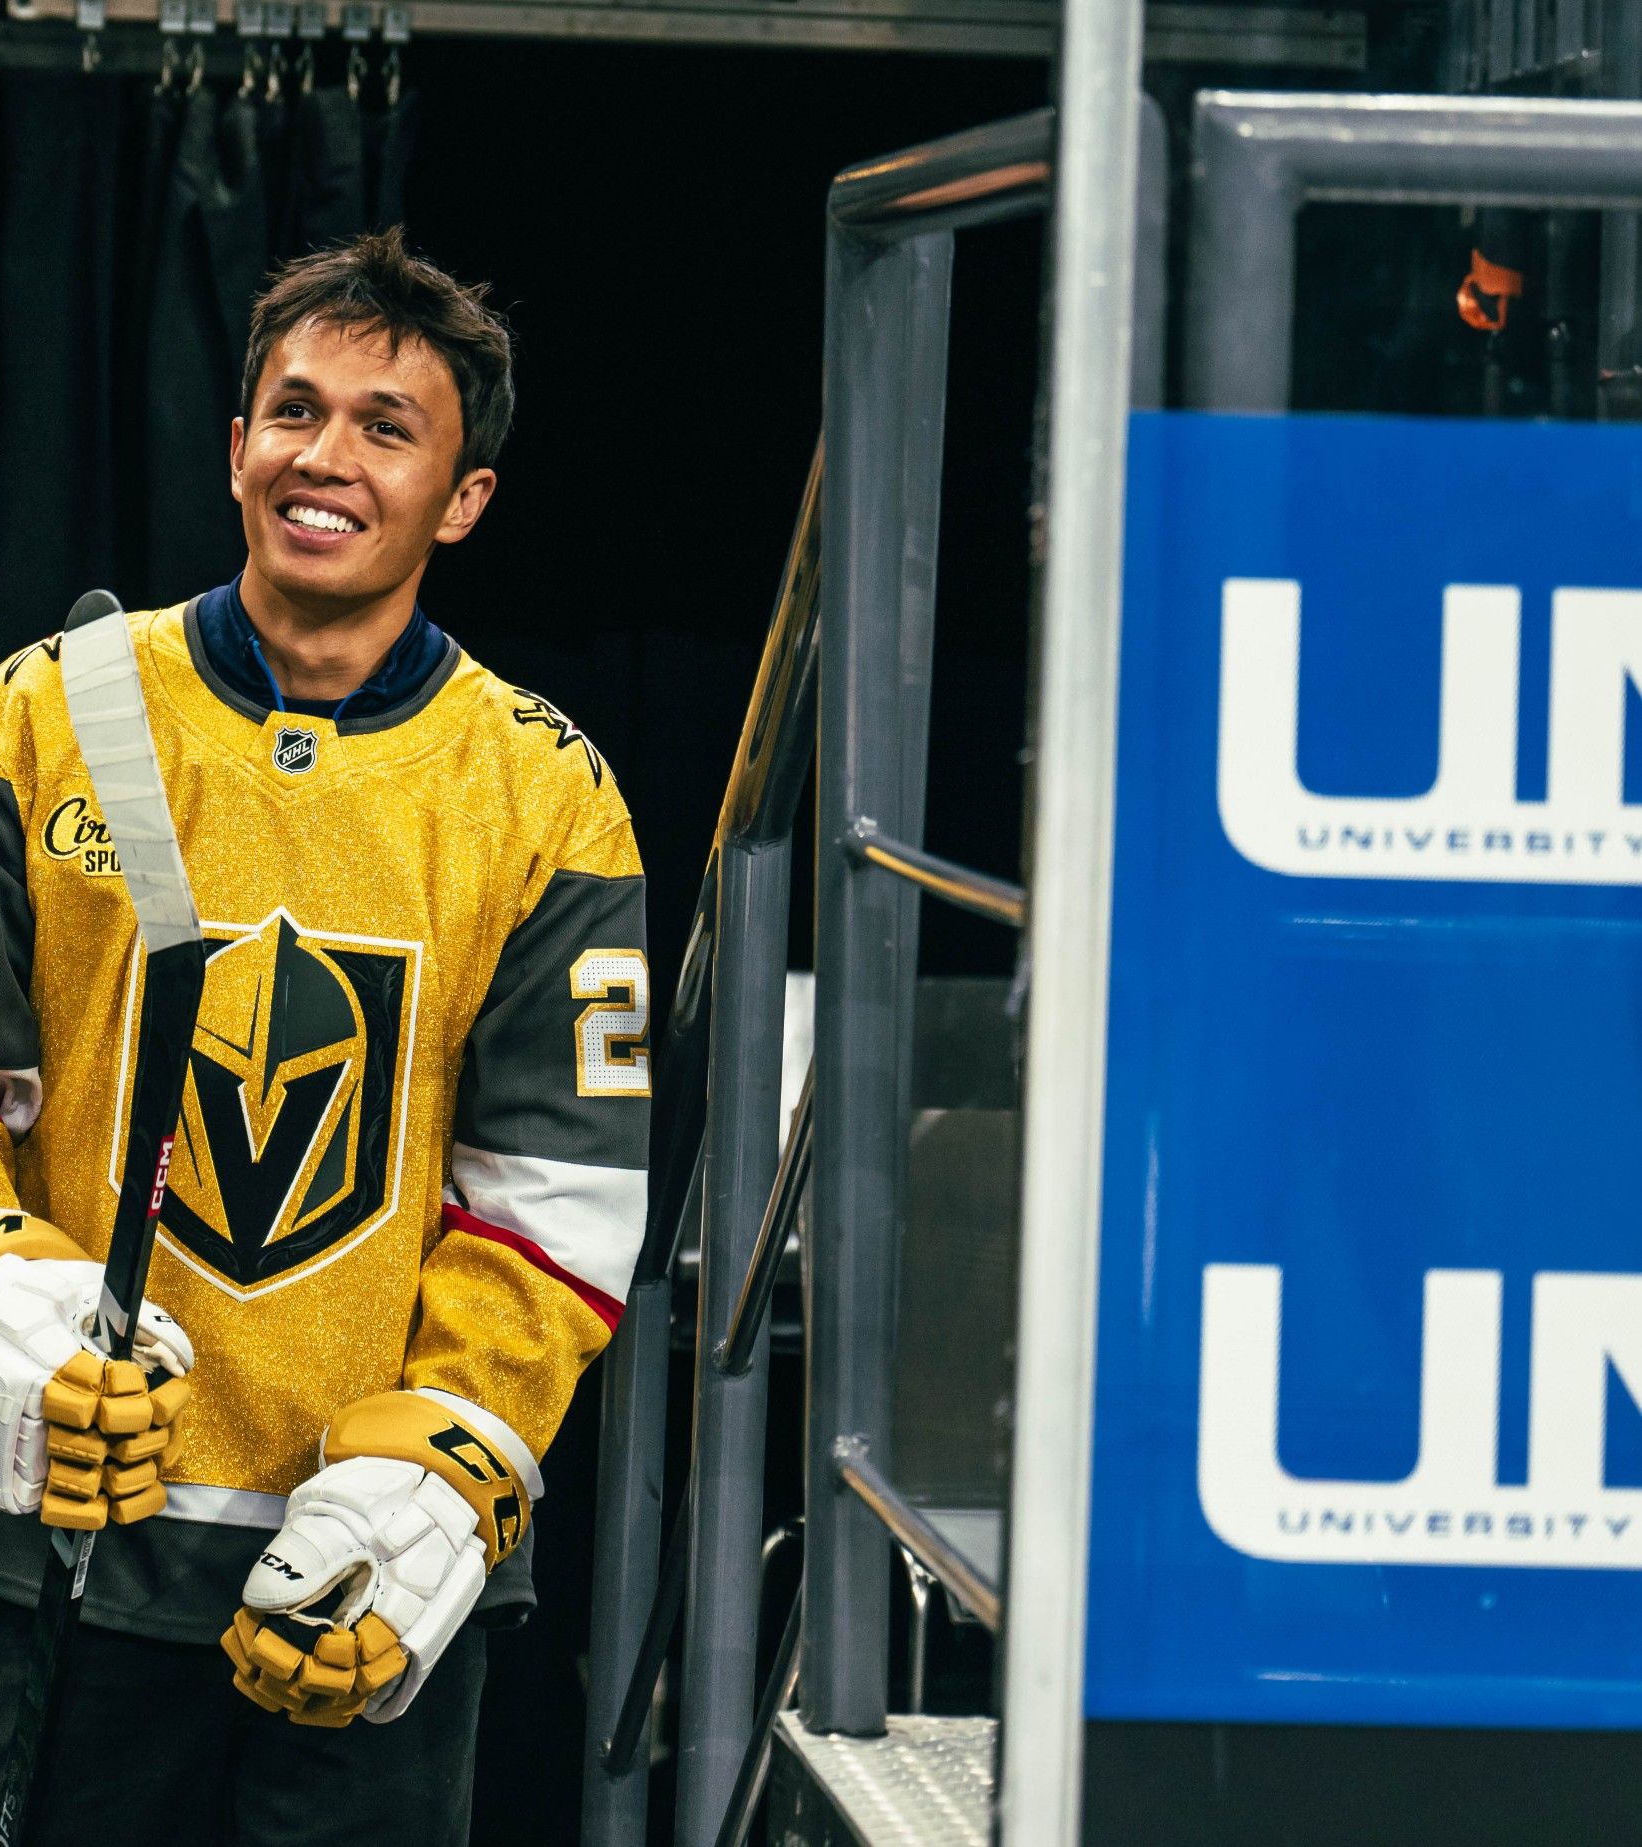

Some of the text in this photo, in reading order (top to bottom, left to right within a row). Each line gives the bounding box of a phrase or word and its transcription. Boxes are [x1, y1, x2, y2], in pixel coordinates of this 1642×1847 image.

[1217, 576, 1642, 886] U
[281, 740, 311, 765] NHL
[150, 1140, 175, 1211] CCM
[1276, 1509, 1632, 1541] UNIVERSITY
[261, 1551, 305, 1581] CM
